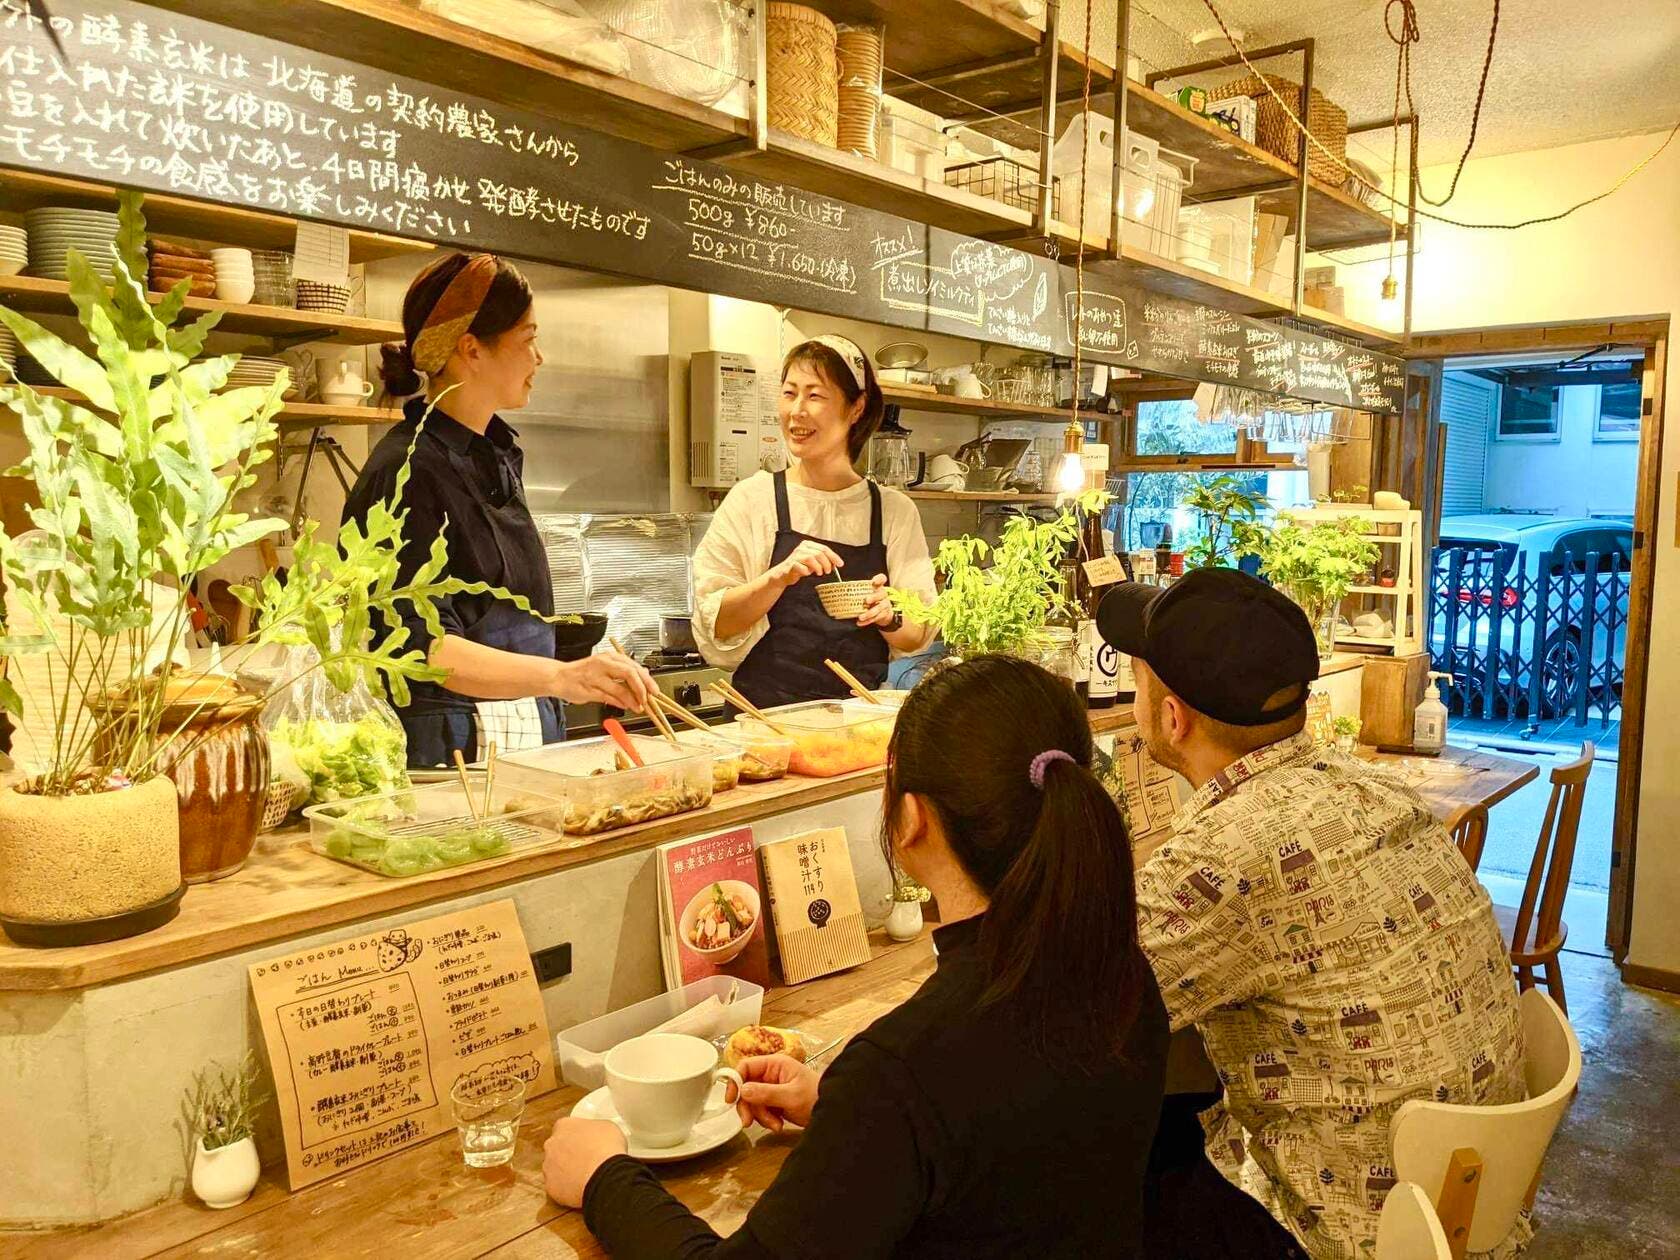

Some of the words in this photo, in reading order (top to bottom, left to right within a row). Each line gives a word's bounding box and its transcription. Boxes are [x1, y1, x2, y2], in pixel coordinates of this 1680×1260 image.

[664, 160, 846, 226] ごはんのみの販売しています
[688, 198, 735, 228] 500g
[673, 841, 753, 874] 酵素玄米どんぶり
[810, 841, 824, 893] おくすり
[296, 971, 333, 990] ごはん
